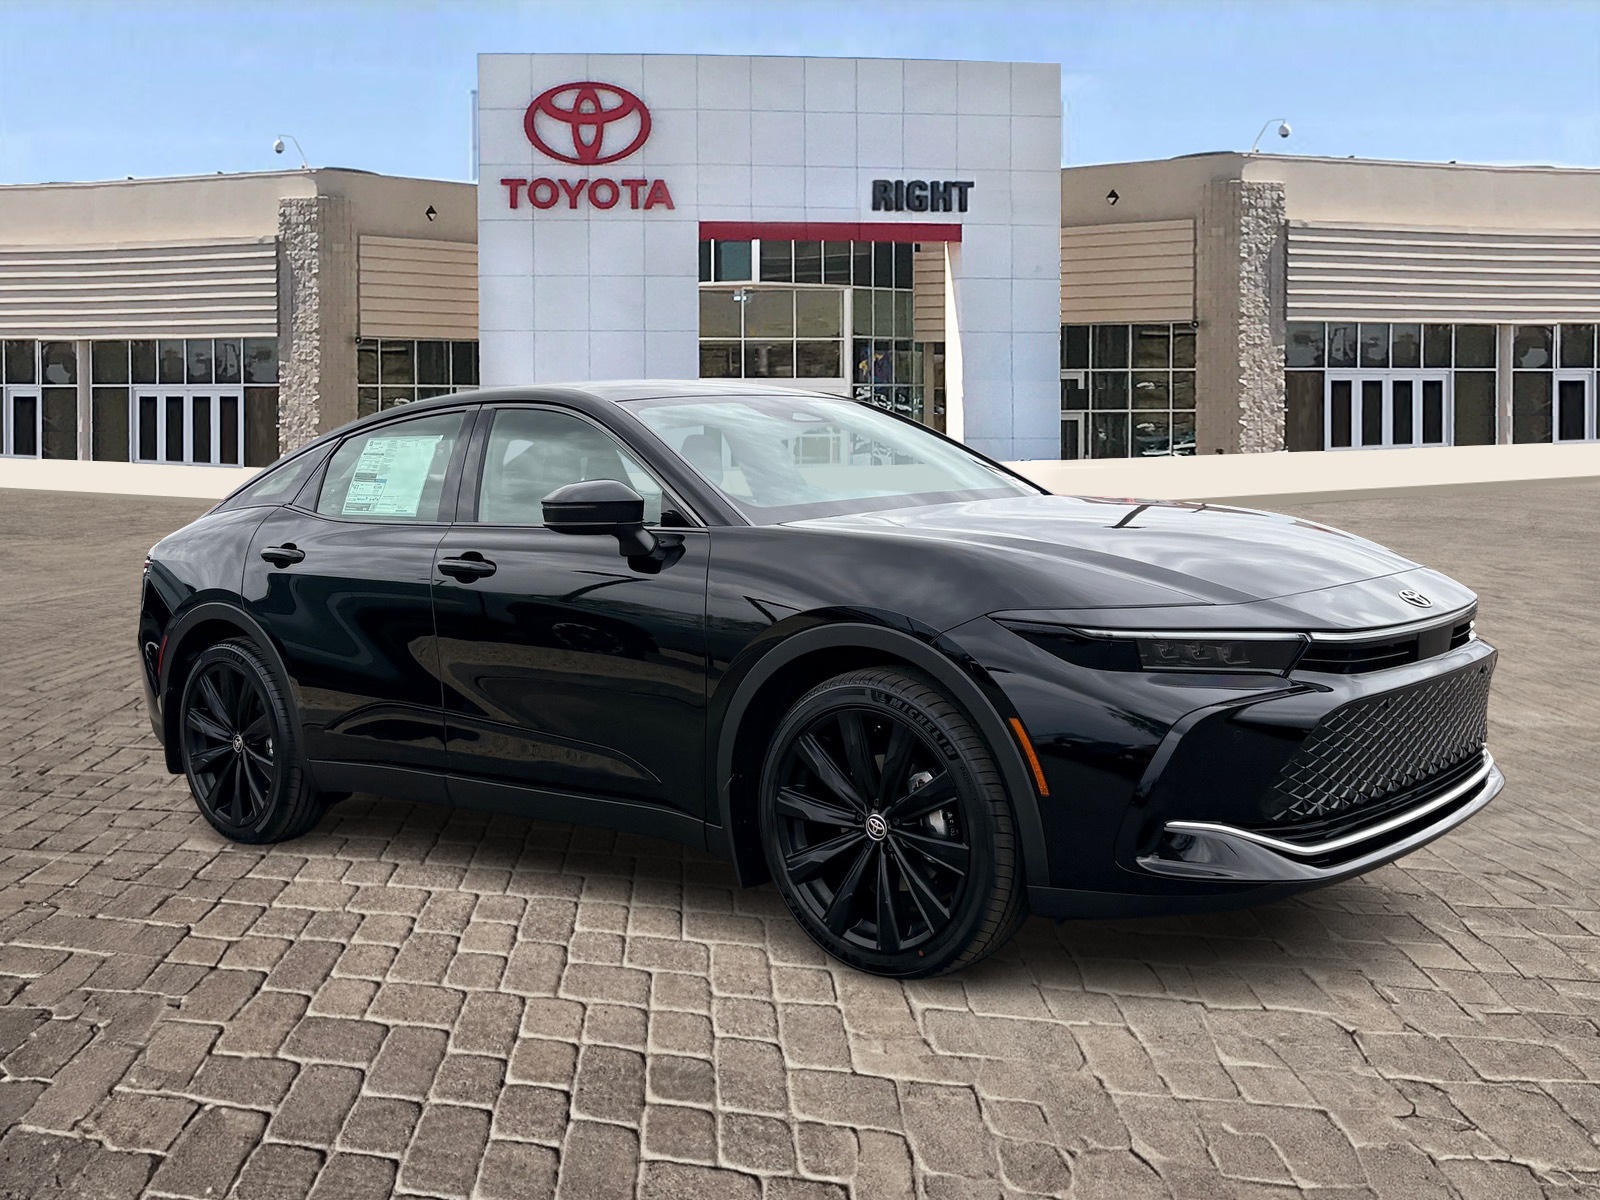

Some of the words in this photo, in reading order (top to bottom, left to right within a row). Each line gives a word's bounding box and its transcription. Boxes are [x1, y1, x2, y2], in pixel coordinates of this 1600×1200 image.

[501, 178, 675, 210] TOYOTA
[871, 179, 974, 213] RIGHT
[889, 698, 957, 757] MICHELIN
